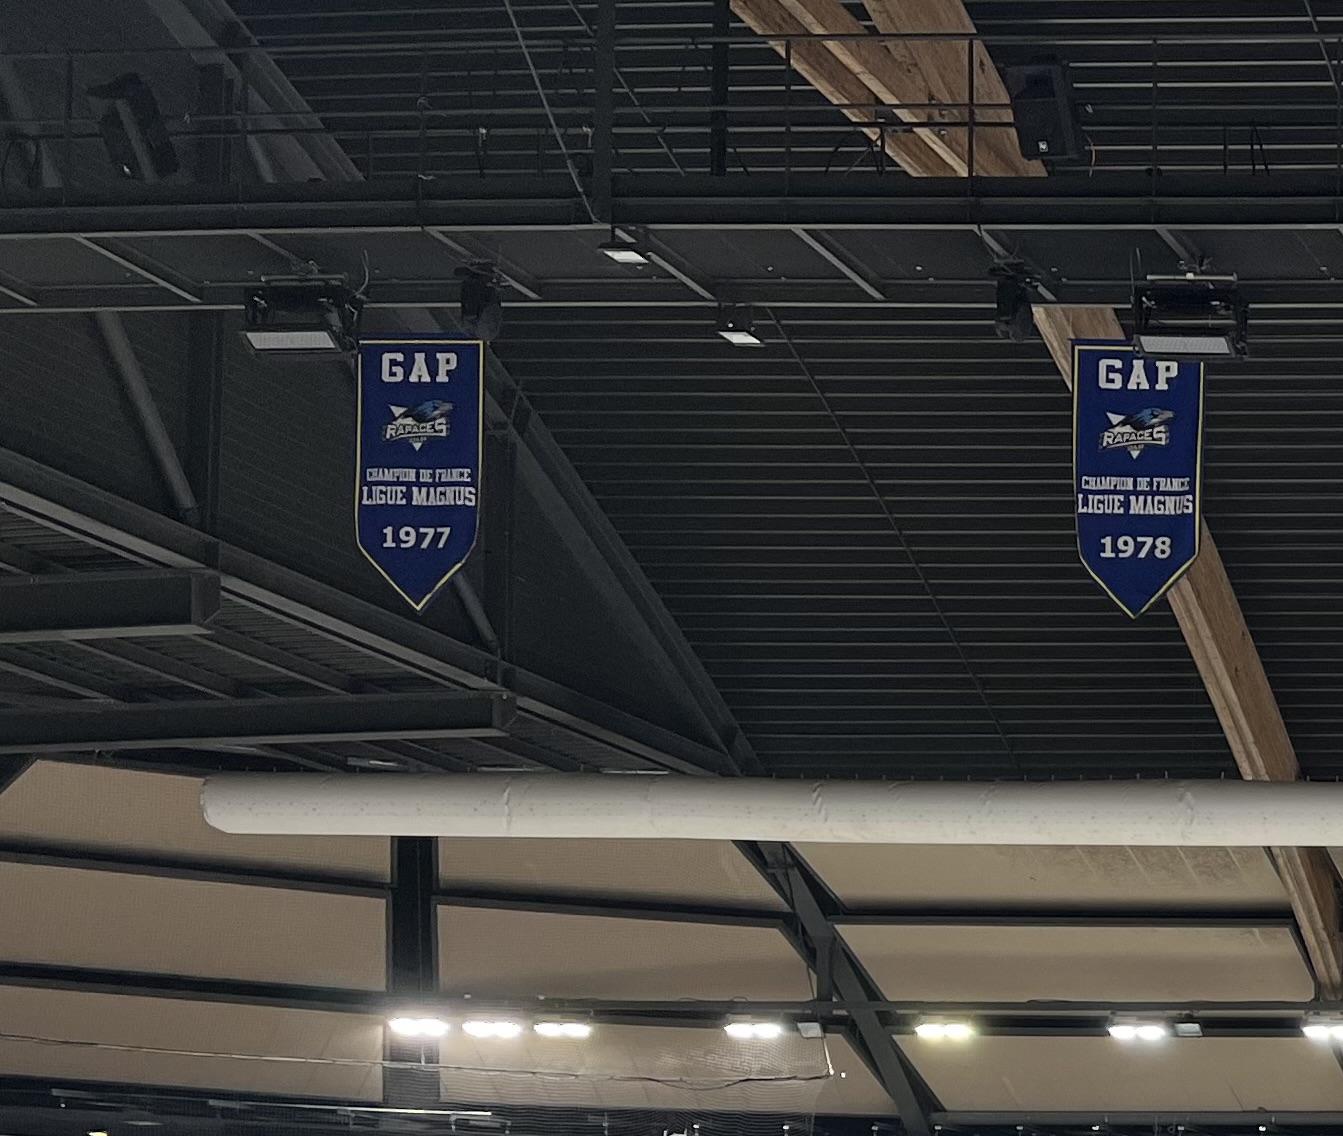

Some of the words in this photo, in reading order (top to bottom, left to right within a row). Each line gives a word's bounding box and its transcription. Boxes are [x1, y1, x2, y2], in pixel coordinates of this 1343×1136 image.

[381, 352, 457, 383] GAP
[1098, 359, 1178, 390] GAP
[386, 418, 447, 440] RAPACES
[1103, 425, 1168, 448] RAPACES
[367, 468, 416, 482] CHAMPION
[420, 469, 433, 482] DE
[435, 469, 471, 482] FRANCE
[1082, 476, 1133, 491] CHAMPION
[1137, 477, 1150, 491] DE
[1153, 477, 1190, 491] FRANCE
[362, 486, 406, 505] LIGUE
[412, 486, 475, 506] MAGNUS
[1077, 494, 1123, 514] LIGUE
[1129, 494, 1193, 515] MAGNUS
[383, 527, 450, 549] 1977
[1100, 537, 1171, 558] 1978
